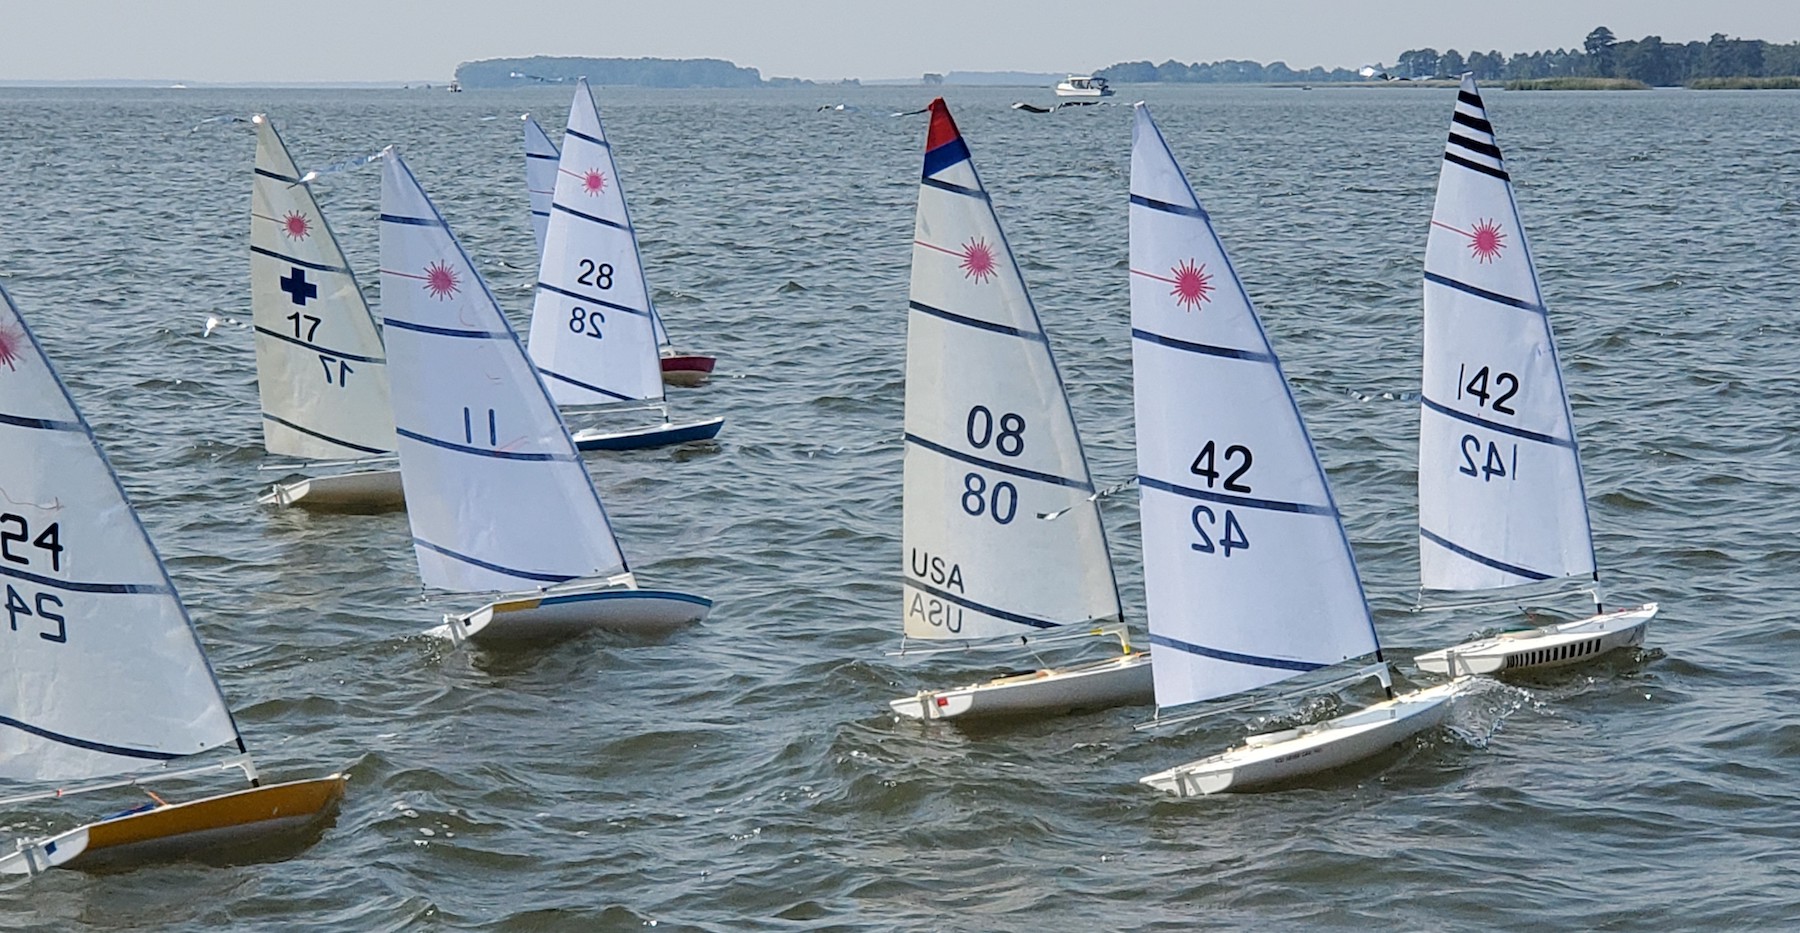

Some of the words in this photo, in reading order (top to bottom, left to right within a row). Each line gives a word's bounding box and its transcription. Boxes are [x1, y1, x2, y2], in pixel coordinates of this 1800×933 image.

[577, 258, 614, 291] 28
[286, 311, 322, 342] 17
[1457, 363, 1519, 415] 142
[464, 406, 496, 446] 11
[966, 405, 1026, 457] 08
[1190, 440, 1253, 494] 42
[0, 513, 64, 572] 24
[911, 548, 965, 594] USA
